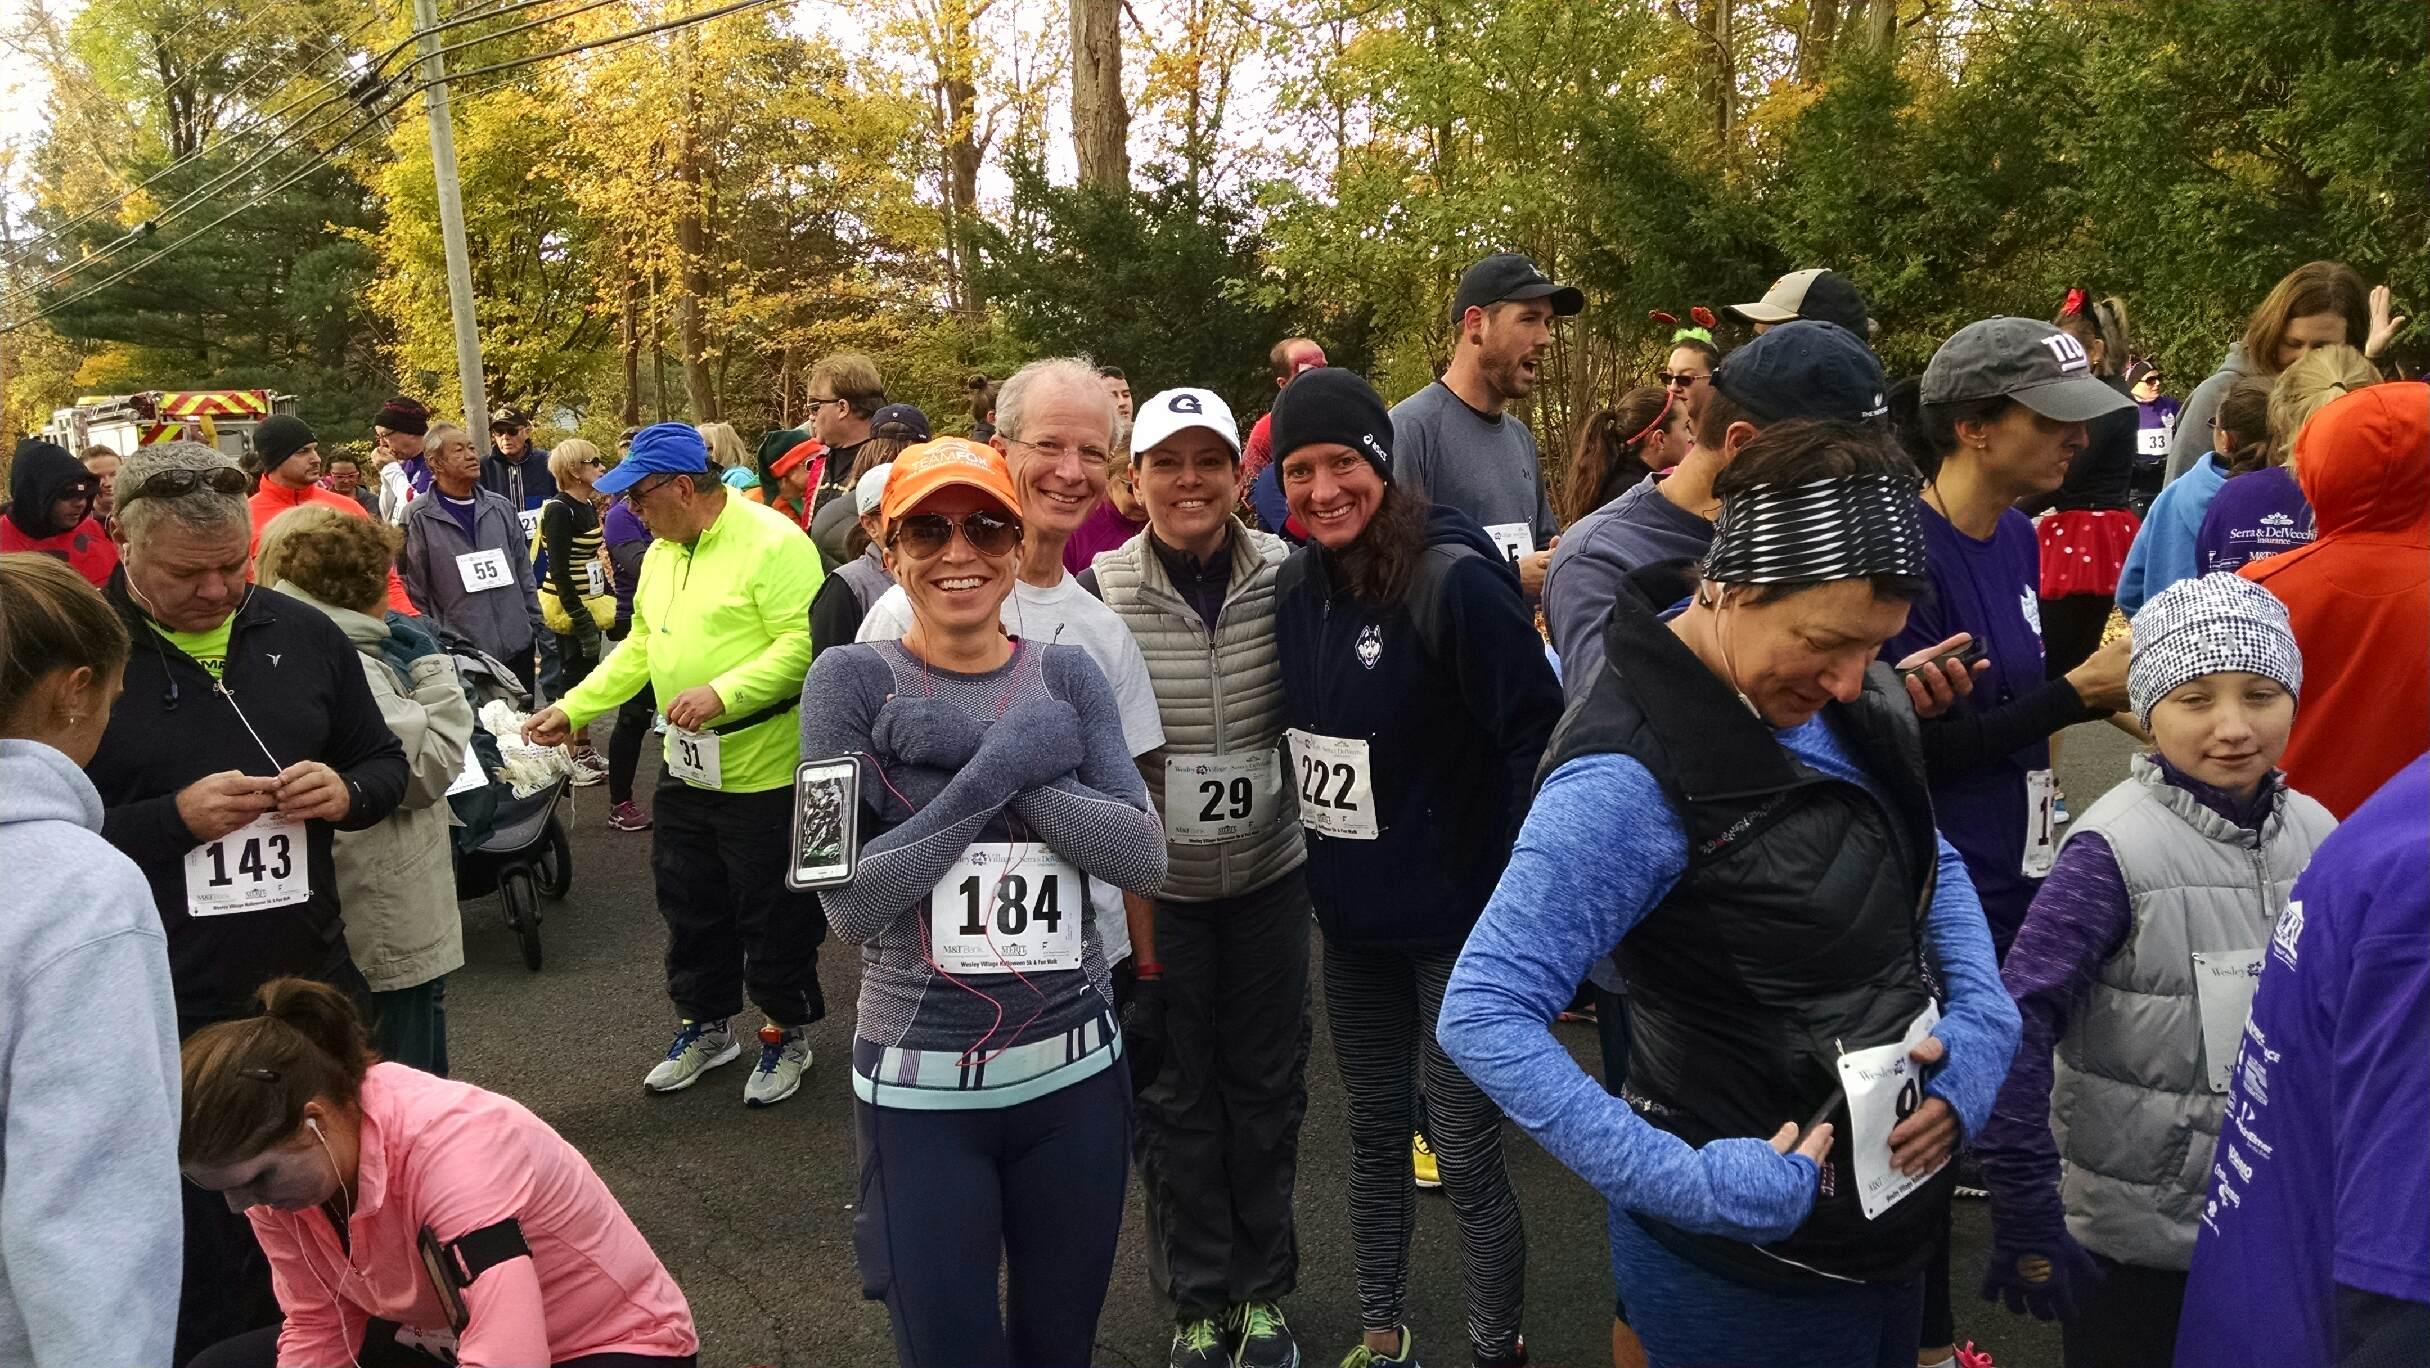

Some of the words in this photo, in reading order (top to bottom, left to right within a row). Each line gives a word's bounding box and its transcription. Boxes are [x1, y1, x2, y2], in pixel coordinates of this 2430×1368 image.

[1168, 394, 1202, 415] G
[2149, 435, 2165, 448] 33
[2229, 528, 2255, 539] Serra
[2256, 528, 2265, 537] &
[2265, 527, 2318, 541] DelVecchi
[473, 560, 498, 580] 55
[680, 739, 704, 771] 31
[1302, 754, 1358, 811] 222
[1200, 777, 1252, 822] 29
[206, 833, 292, 887] 143
[960, 874, 1062, 936] 184
